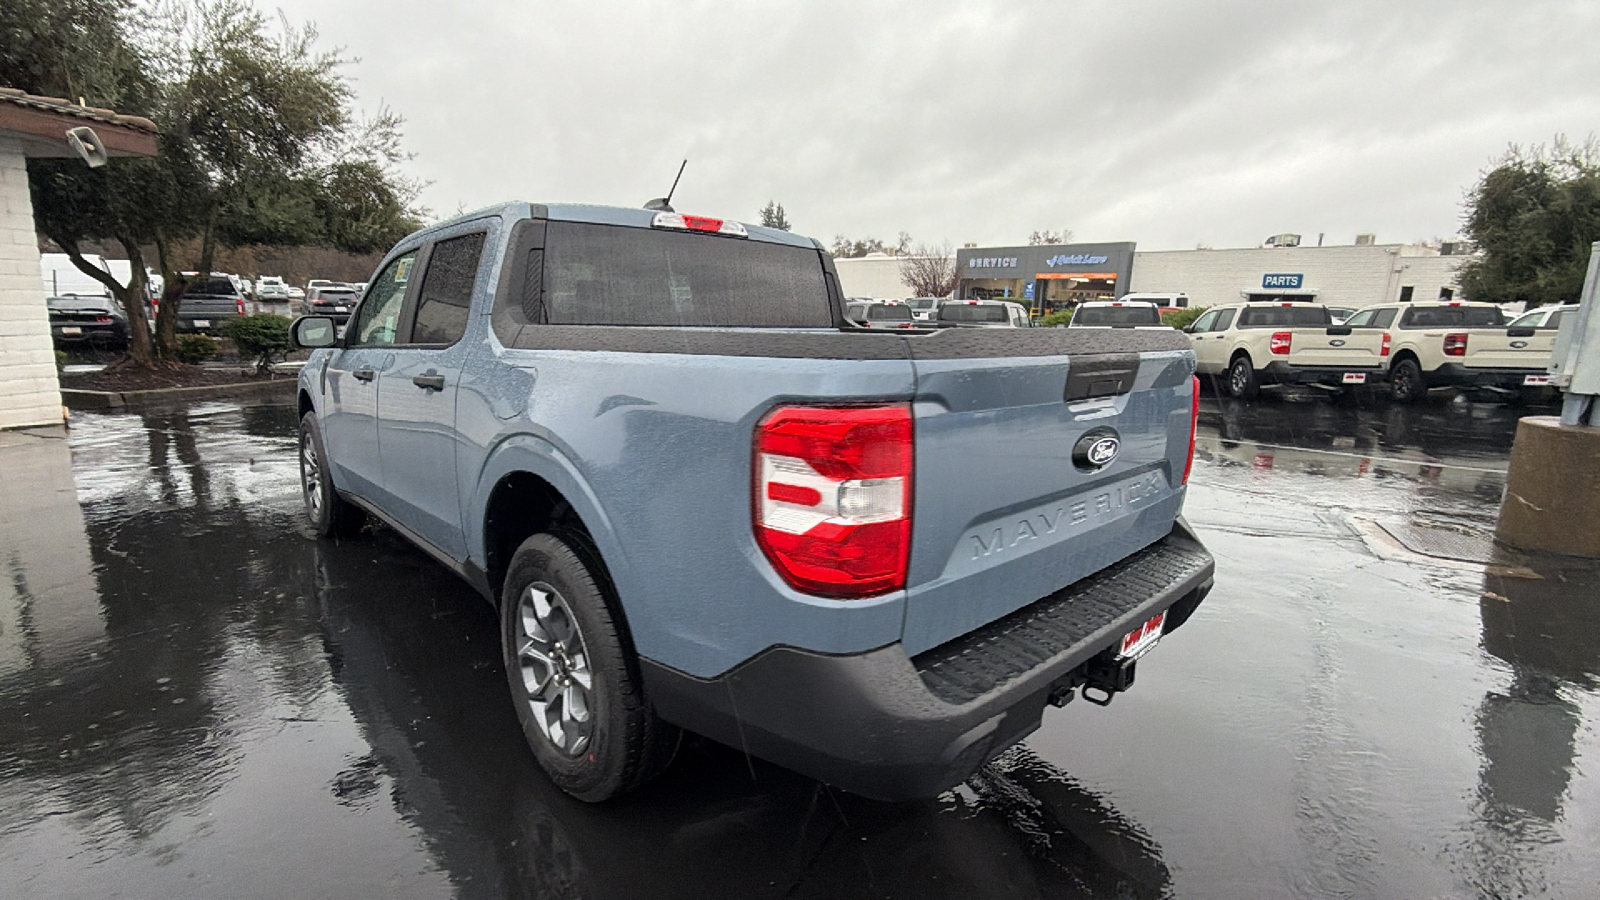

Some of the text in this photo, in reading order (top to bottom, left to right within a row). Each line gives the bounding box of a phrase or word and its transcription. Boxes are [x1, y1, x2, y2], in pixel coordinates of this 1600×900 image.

[969, 257, 1018, 268] SERVICE
[1265, 276, 1299, 286] PARTS
[1094, 438, 1116, 461] Ford
[969, 468, 1160, 561] MAVERICK
